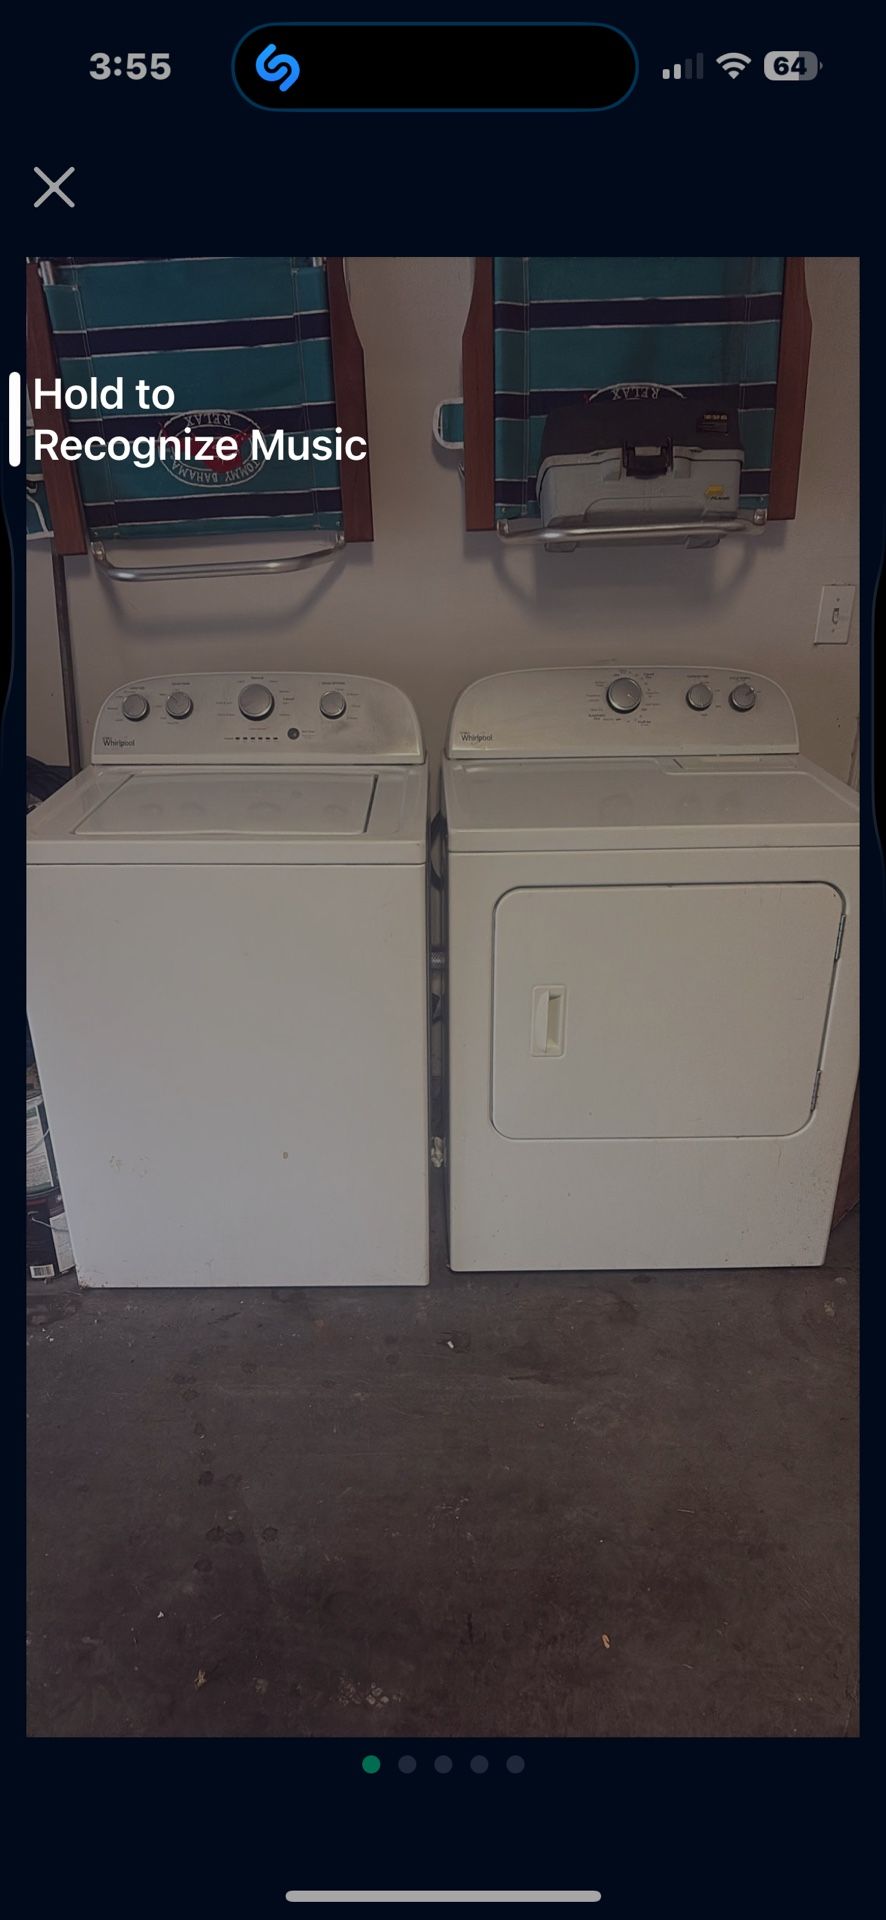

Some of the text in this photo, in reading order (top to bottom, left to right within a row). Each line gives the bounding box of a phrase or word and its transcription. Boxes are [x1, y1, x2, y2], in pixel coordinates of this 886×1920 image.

[611, 387, 660, 400] RELAX
[184, 413, 231, 428] RELAX
[172, 459, 260, 483] TOMMY BAHAMA
[102, 737, 135, 747] Whirlpool
[461, 733, 493, 743] Whirlpool
